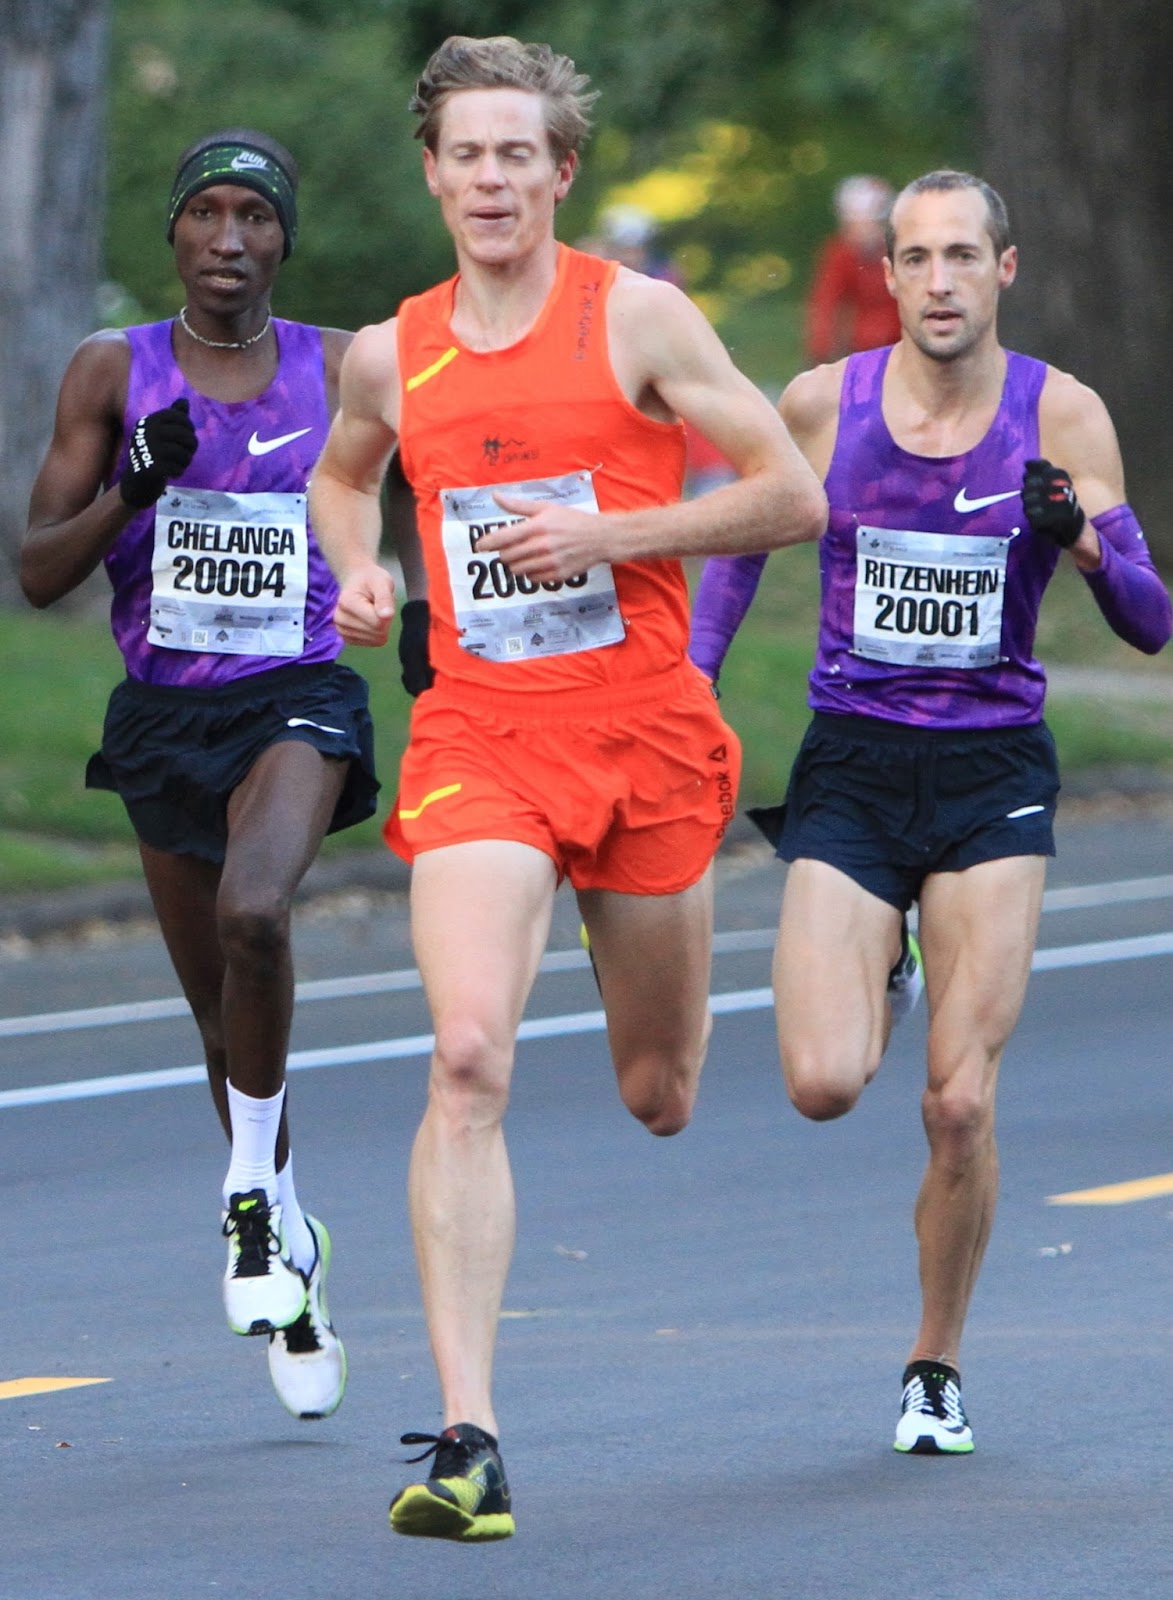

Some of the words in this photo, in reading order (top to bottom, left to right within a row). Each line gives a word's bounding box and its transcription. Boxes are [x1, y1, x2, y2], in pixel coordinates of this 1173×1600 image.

[239, 150, 268, 167] RUN
[167, 520, 295, 555] CHELANGA
[172, 555, 286, 598] 20004
[864, 559, 999, 596] RITZENHEIN
[874, 593, 979, 636] 20001
